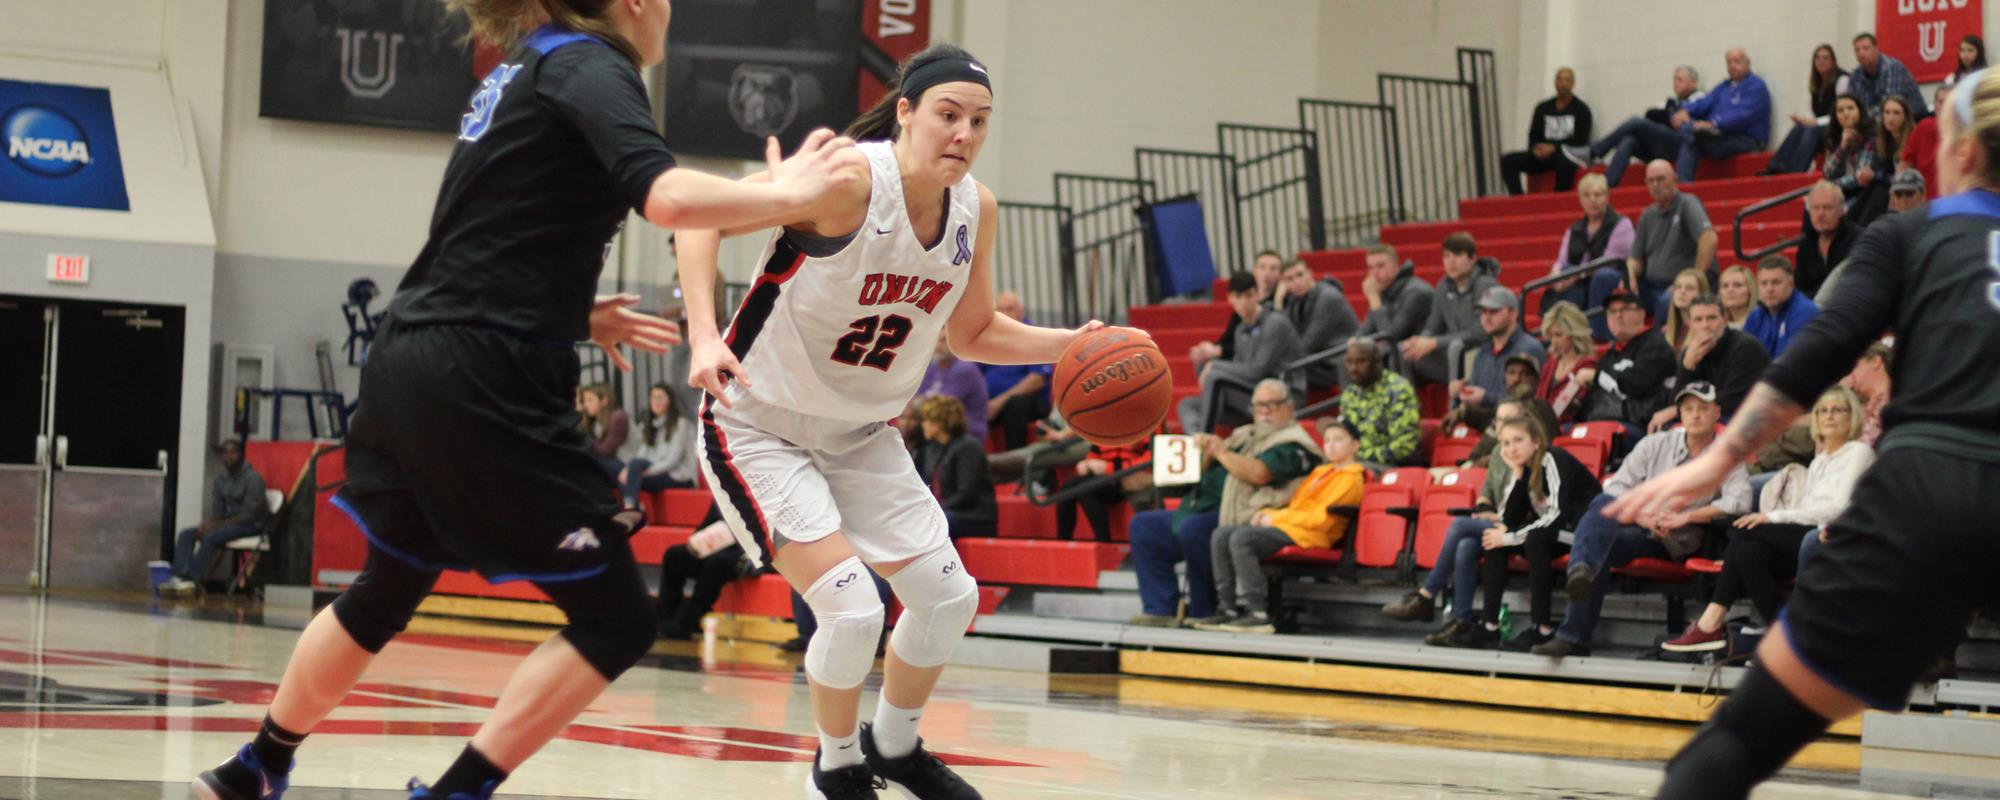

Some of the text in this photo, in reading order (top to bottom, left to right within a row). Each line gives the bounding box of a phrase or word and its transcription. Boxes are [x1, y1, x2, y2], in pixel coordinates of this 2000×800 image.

[1917, 20, 1947, 62] U
[337, 28, 404, 98] U
[9, 136, 90, 164] NCAA
[55, 255, 85, 281] EXIT
[858, 273, 953, 314] UNION
[830, 313, 914, 372] 22
[1080, 352, 1156, 395] Wilson
[1168, 439, 1187, 475] 3
